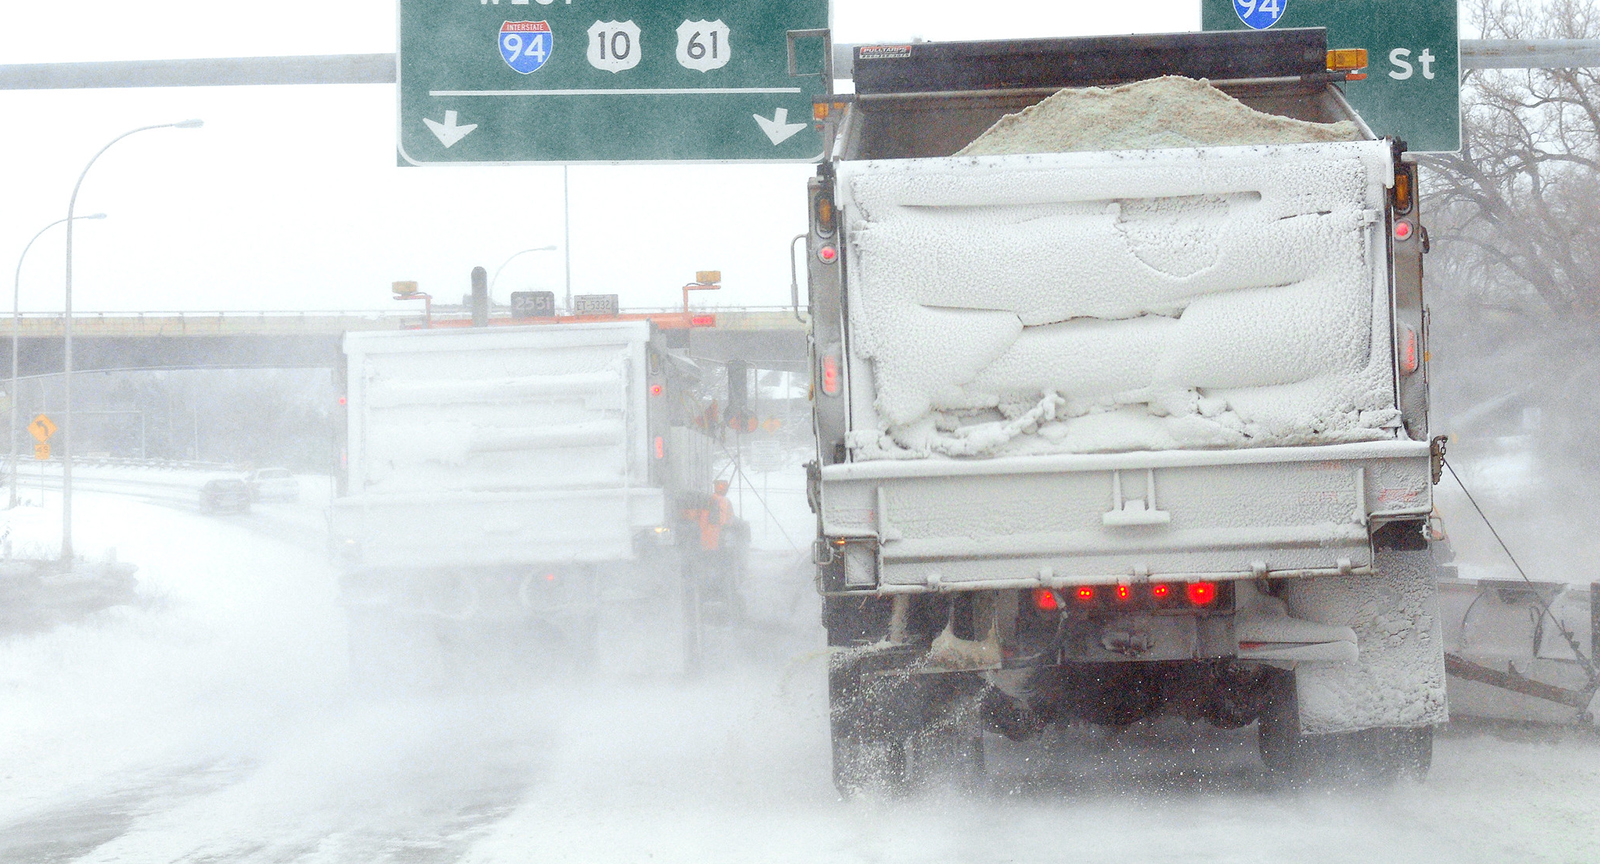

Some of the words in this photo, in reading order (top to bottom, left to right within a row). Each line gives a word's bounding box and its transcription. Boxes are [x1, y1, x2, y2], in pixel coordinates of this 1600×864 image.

[1240, 0, 1280, 18] 94
[506, 23, 544, 31] INTERSTATE
[503, 34, 545, 62] 94
[598, 31, 631, 60] 10
[687, 31, 718, 60] 61
[1388, 47, 1435, 80] St
[515, 297, 551, 310] 2551
